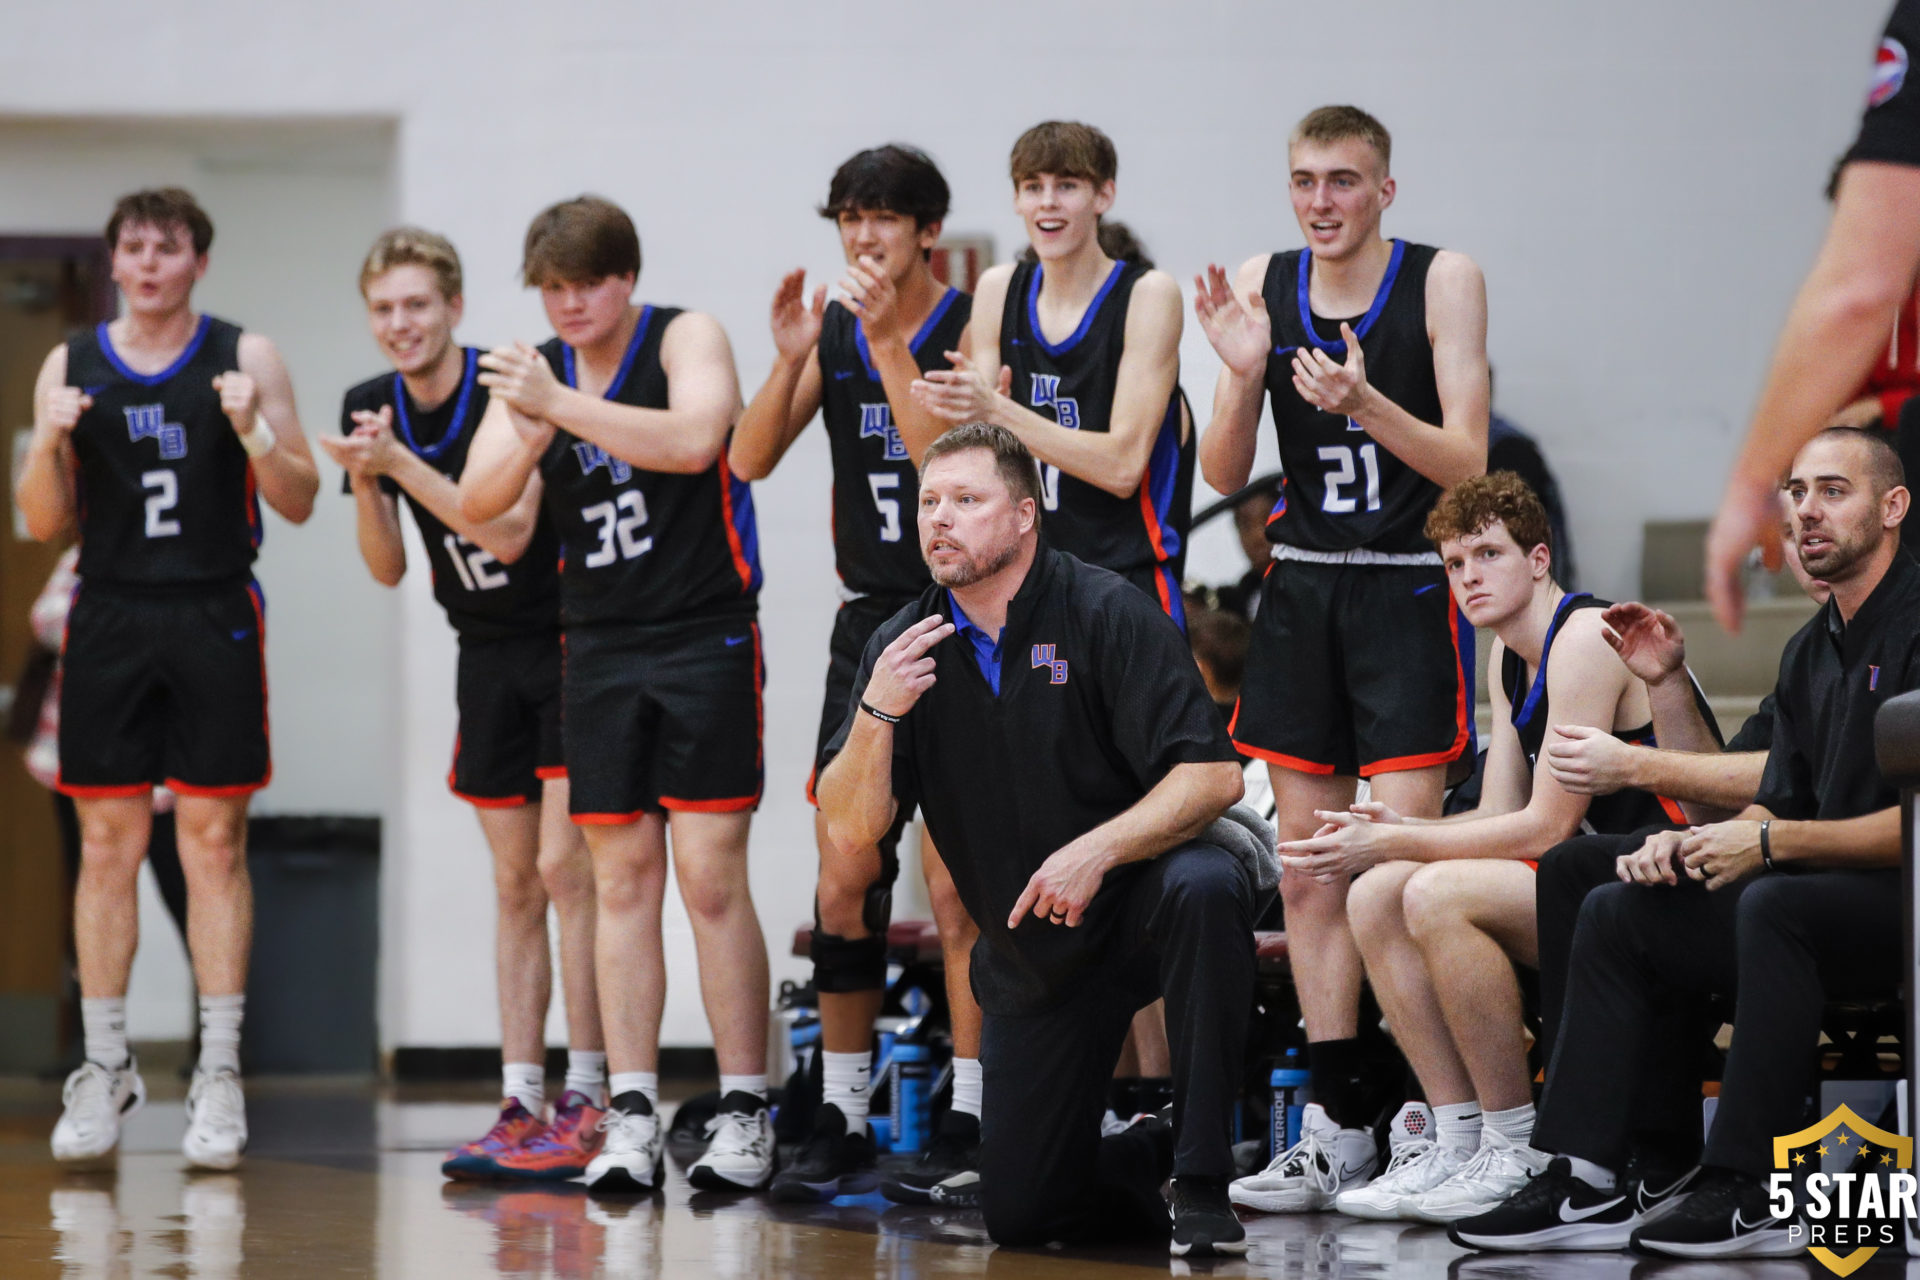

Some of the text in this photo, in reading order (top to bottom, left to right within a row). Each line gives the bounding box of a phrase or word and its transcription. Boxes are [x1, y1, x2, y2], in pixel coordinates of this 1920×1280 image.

[123, 403, 188, 459] WB
[1031, 373, 1080, 430] WB
[141, 469, 181, 538] 2
[868, 473, 902, 542] 5
[1317, 443, 1380, 513] 21
[444, 533, 509, 591] 12
[581, 489, 653, 568] 32
[1031, 643, 1068, 684] WB
[1274, 1089, 1285, 1157] WERADE
